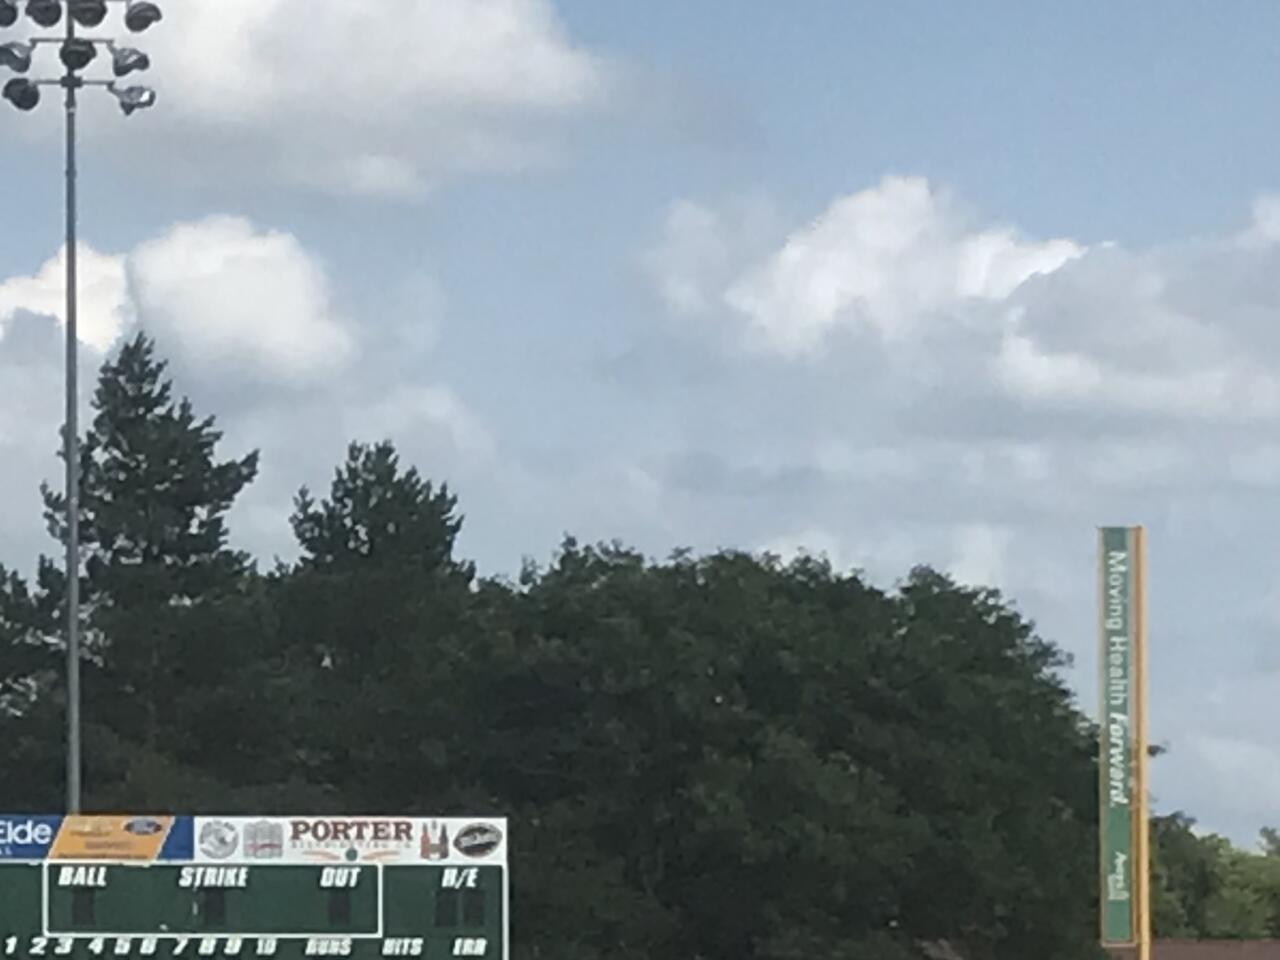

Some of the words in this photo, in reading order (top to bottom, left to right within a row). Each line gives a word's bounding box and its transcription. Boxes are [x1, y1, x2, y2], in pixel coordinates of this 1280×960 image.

[1106, 550, 1128, 629] Moving
[1110, 636, 1128, 704] Health
[290, 820, 414, 841] PORTER
[58, 866, 107, 886] BALL
[178, 866, 249, 888] STRIKE
[320, 867, 361, 888] OUT
[4, 936, 18, 955] 1
[28, 936, 48, 955] 2
[54, 936, 74, 955] 3
[87, 936, 105, 955] 4
[172, 936, 190, 955] 7
[382, 938, 424, 956] HITS
